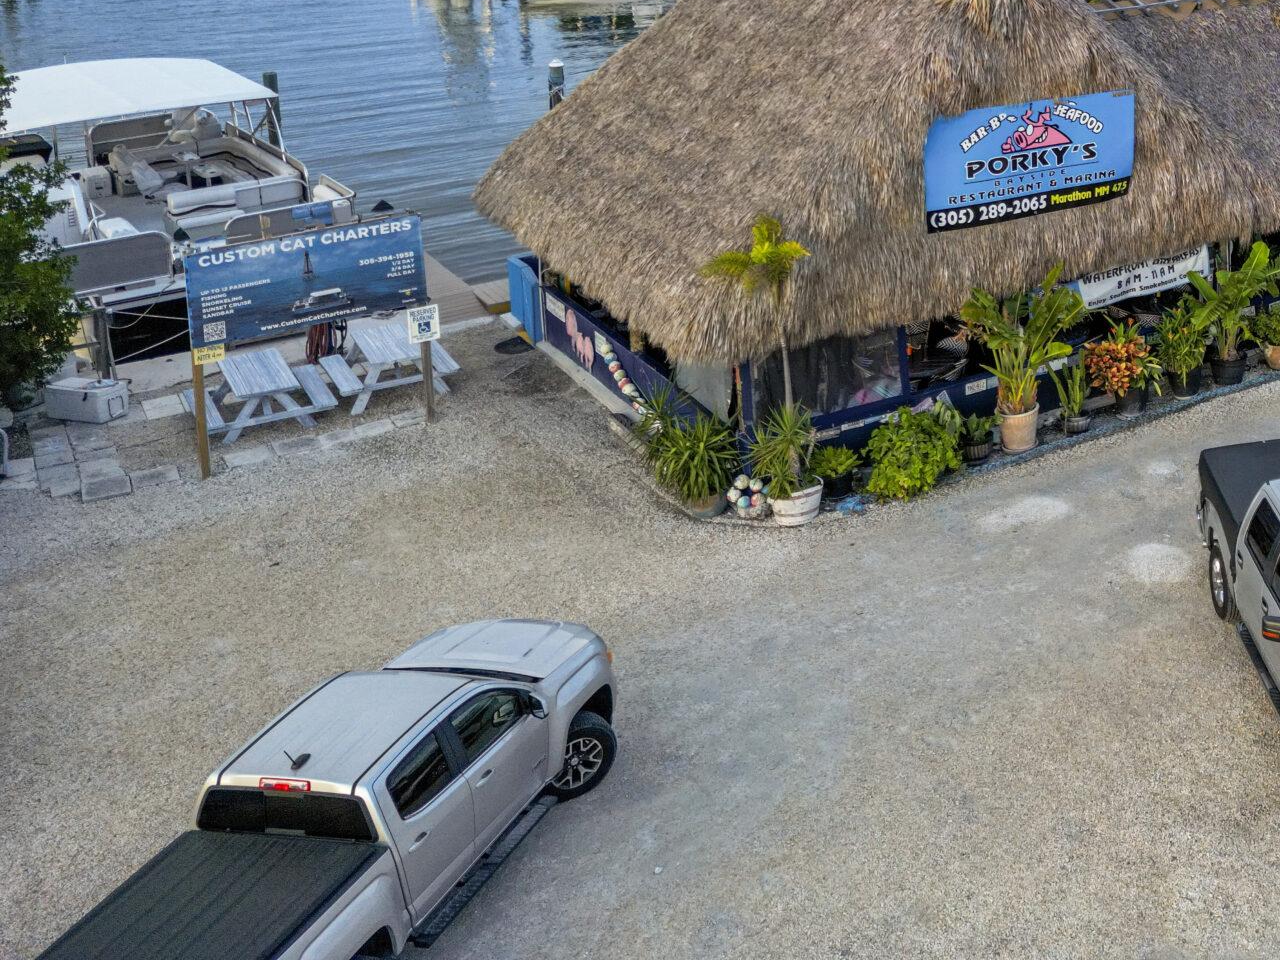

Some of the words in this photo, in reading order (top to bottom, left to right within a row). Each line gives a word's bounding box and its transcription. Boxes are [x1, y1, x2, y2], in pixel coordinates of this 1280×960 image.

[965, 142, 1098, 180] PORKY'S
[994, 169, 1067, 187] BAYSIDE
[948, 182, 1043, 205] RESTAURANT
[1050, 179, 1057, 187] &
[1064, 170, 1116, 185] MARINA
[930, 208, 975, 229] (305)
[979, 195, 1047, 221] 289-2065
[1051, 186, 1092, 205] Marathon
[1094, 186, 1110, 198] MM
[198, 243, 276, 268] CUSTOM
[280, 236, 316, 253] CAT
[320, 220, 413, 244] CHARTERS
[229, 278, 271, 291] PASSENGERS
[1088, 297, 1107, 307] Enjoy
[1109, 287, 1137, 301] Southern
[1139, 276, 1178, 291] Smokehouse
[201, 293, 227, 302] FISHING
[201, 296, 243, 308] SNORKELING
[202, 304, 228, 314] SUNSET
[229, 299, 252, 308] CRUISE
[203, 309, 234, 319] SANDBAR
[410, 306, 437, 318] RESERVED
[260, 306, 367, 331] www.CustomCatCharters.com
[412, 313, 435, 323] PARKING
